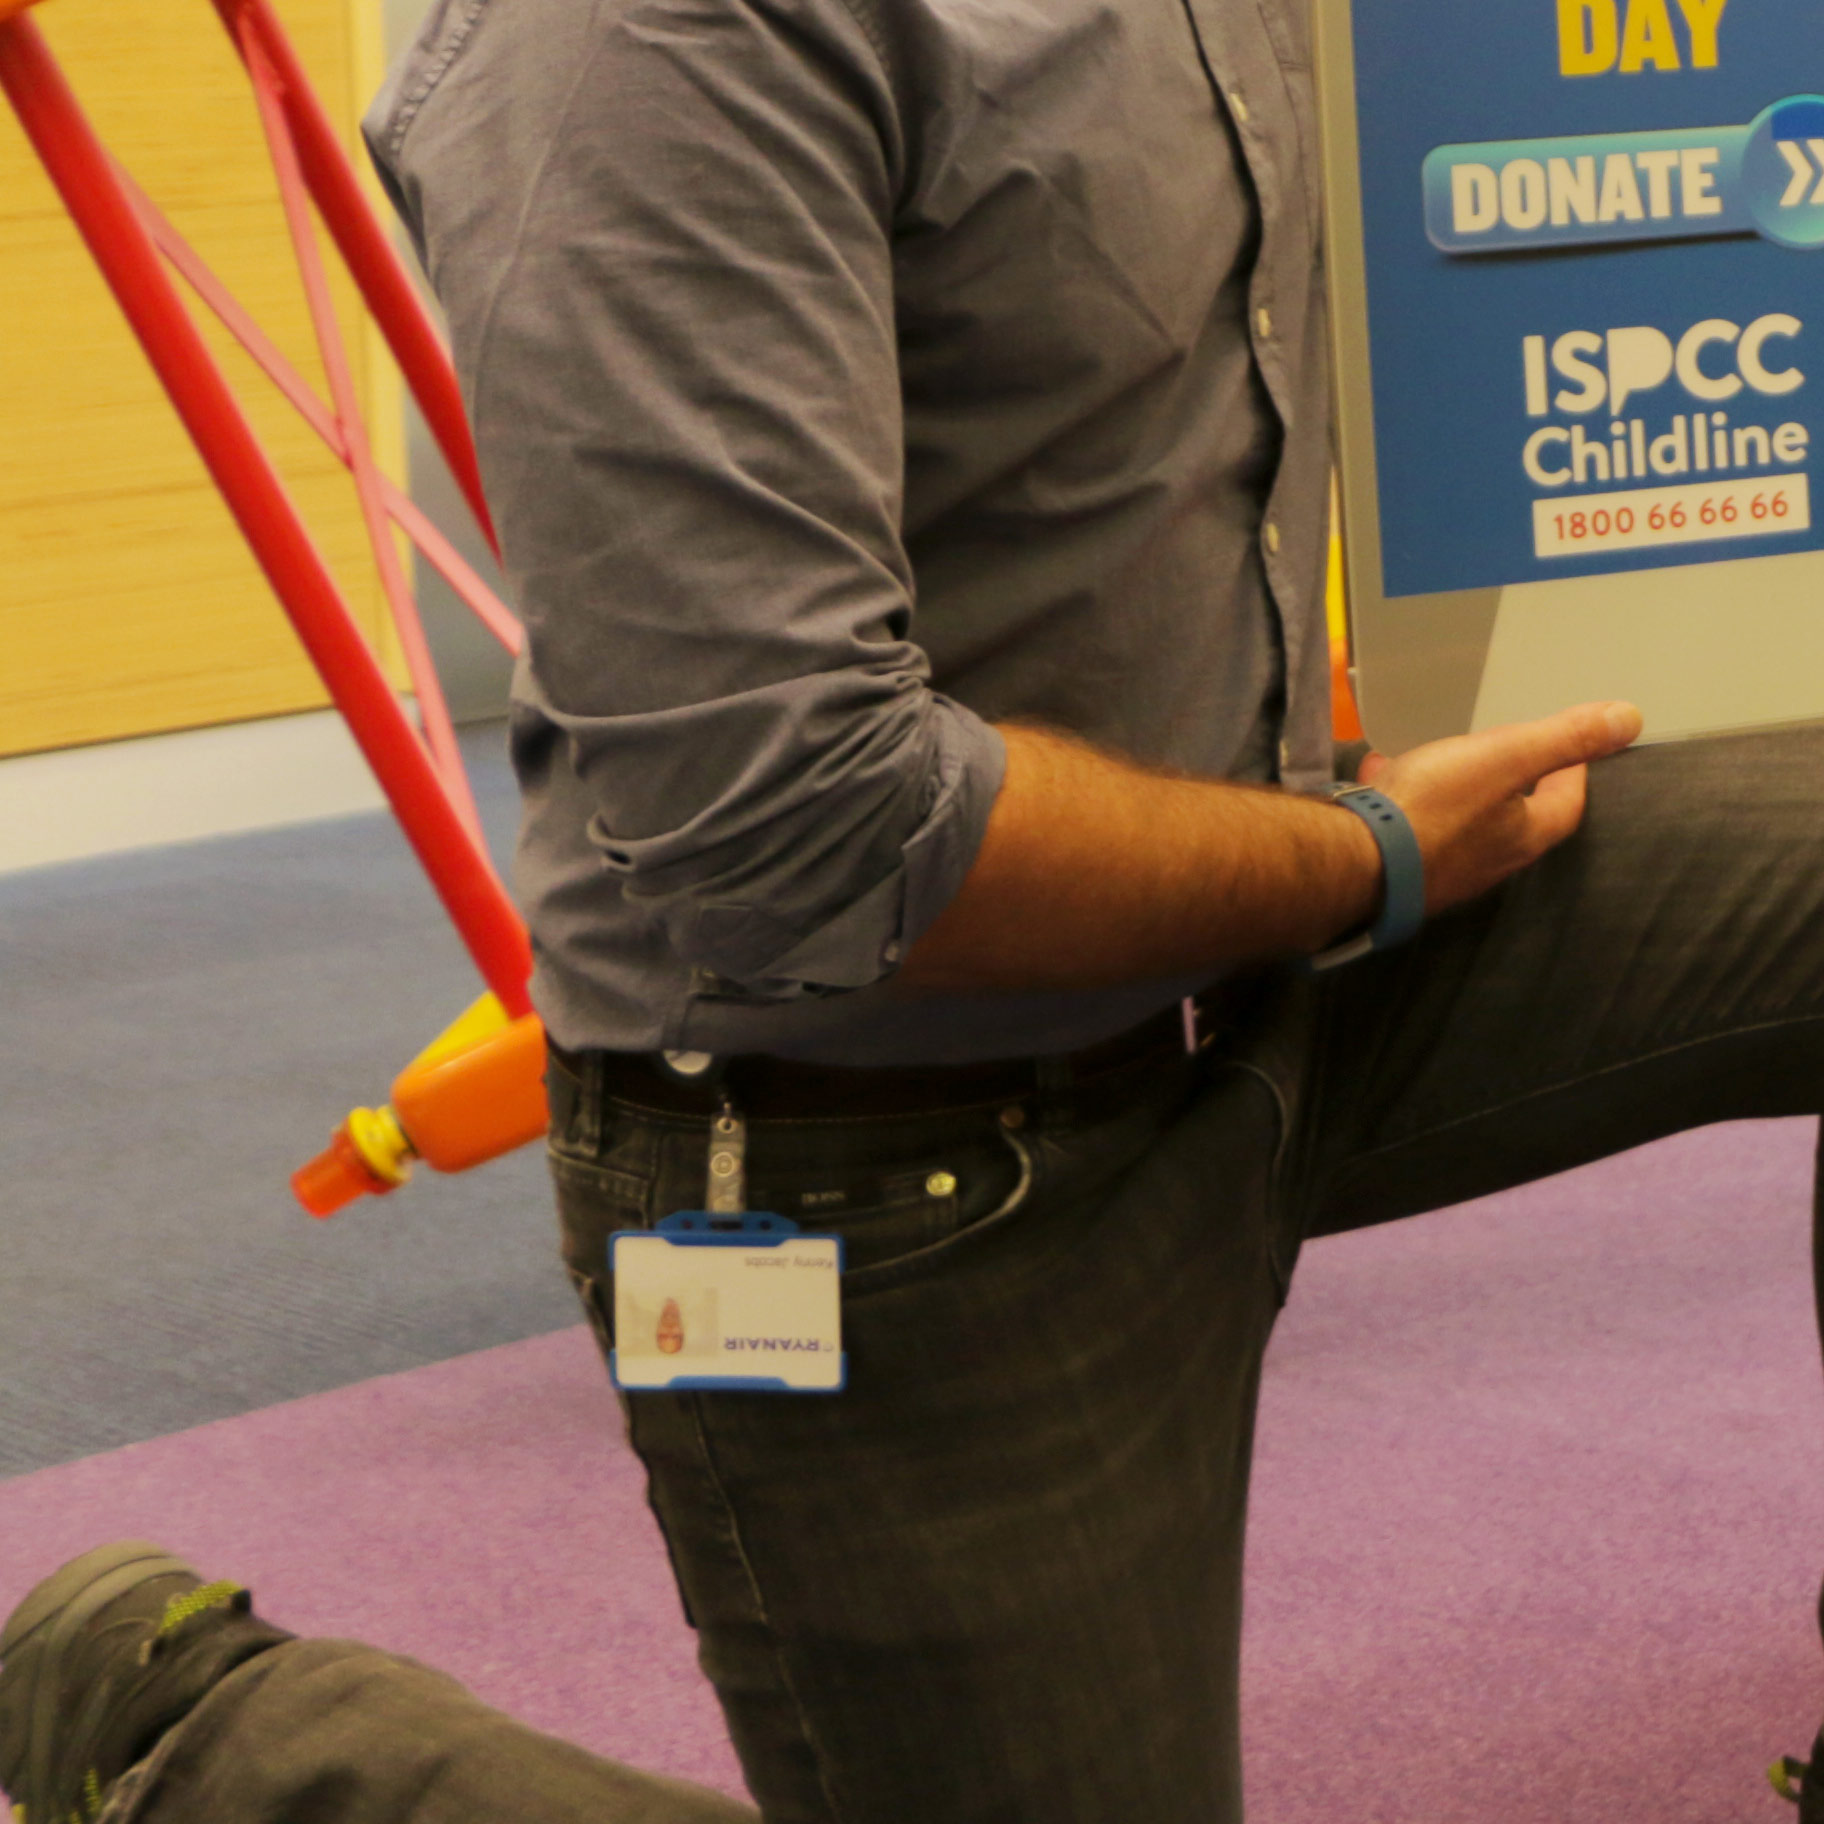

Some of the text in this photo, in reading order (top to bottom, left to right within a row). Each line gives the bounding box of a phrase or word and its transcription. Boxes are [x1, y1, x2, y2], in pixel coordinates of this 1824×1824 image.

[1450, 146, 1722, 234] DONATE
[1522, 312, 1806, 417] ISPCC
[1522, 411, 1810, 487] Childline
[1554, 490, 1789, 540] 1800 66 66 66
[724, 1337, 820, 1352] RYANAIR
